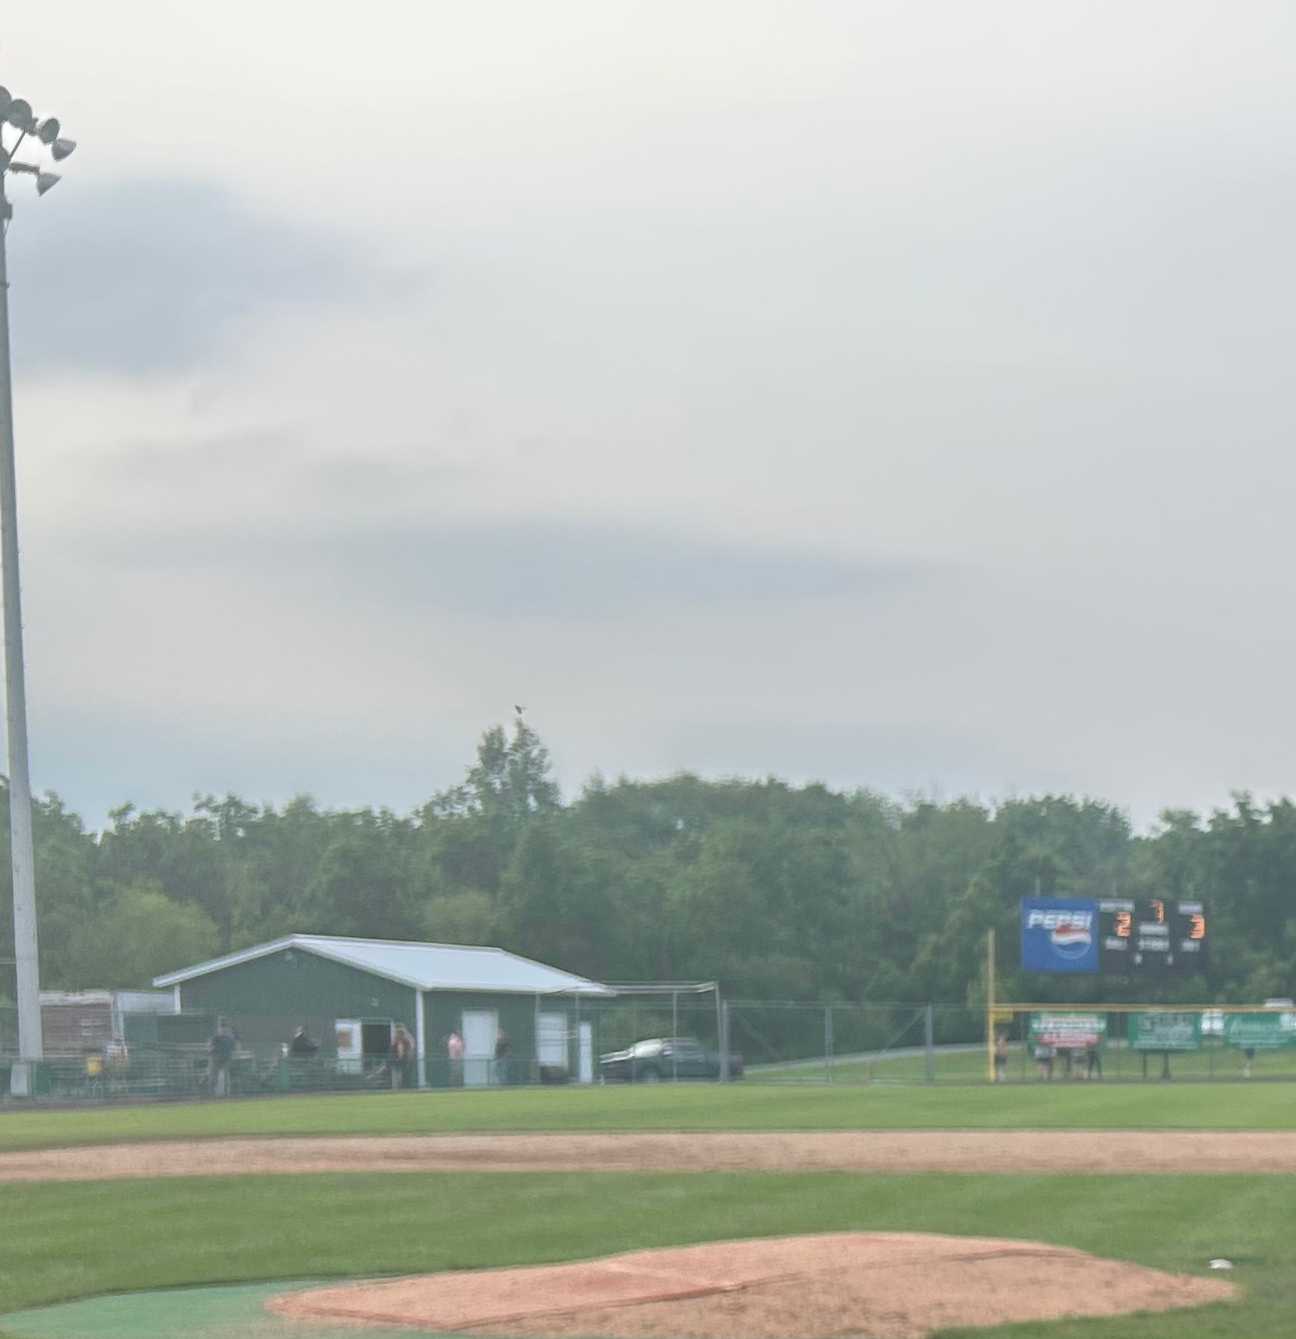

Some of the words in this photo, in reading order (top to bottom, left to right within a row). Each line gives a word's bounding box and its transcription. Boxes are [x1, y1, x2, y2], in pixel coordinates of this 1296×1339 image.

[1026, 909, 1093, 930] PEPSI
[1114, 911, 1132, 937] 2
[1188, 914, 1206, 940] 3
